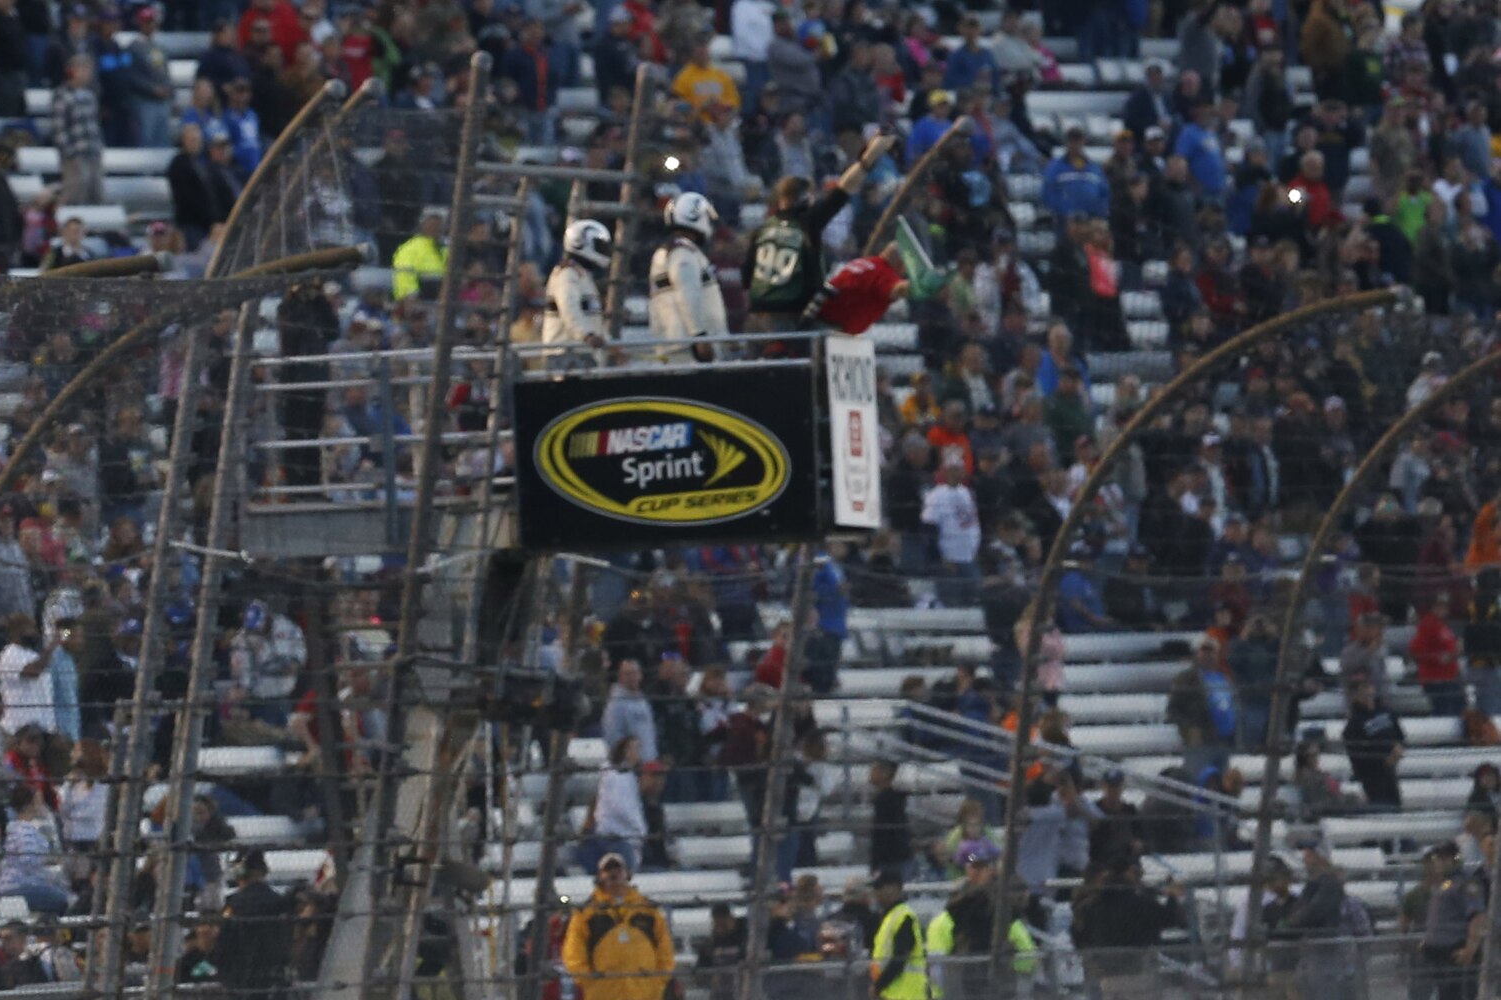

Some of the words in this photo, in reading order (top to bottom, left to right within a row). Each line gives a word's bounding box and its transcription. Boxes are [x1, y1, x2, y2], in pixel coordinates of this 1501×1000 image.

[606, 421, 690, 454] NASCAR
[622, 451, 704, 489] Sprint
[636, 496, 681, 513] CUP
[683, 489, 759, 509] SERIES
